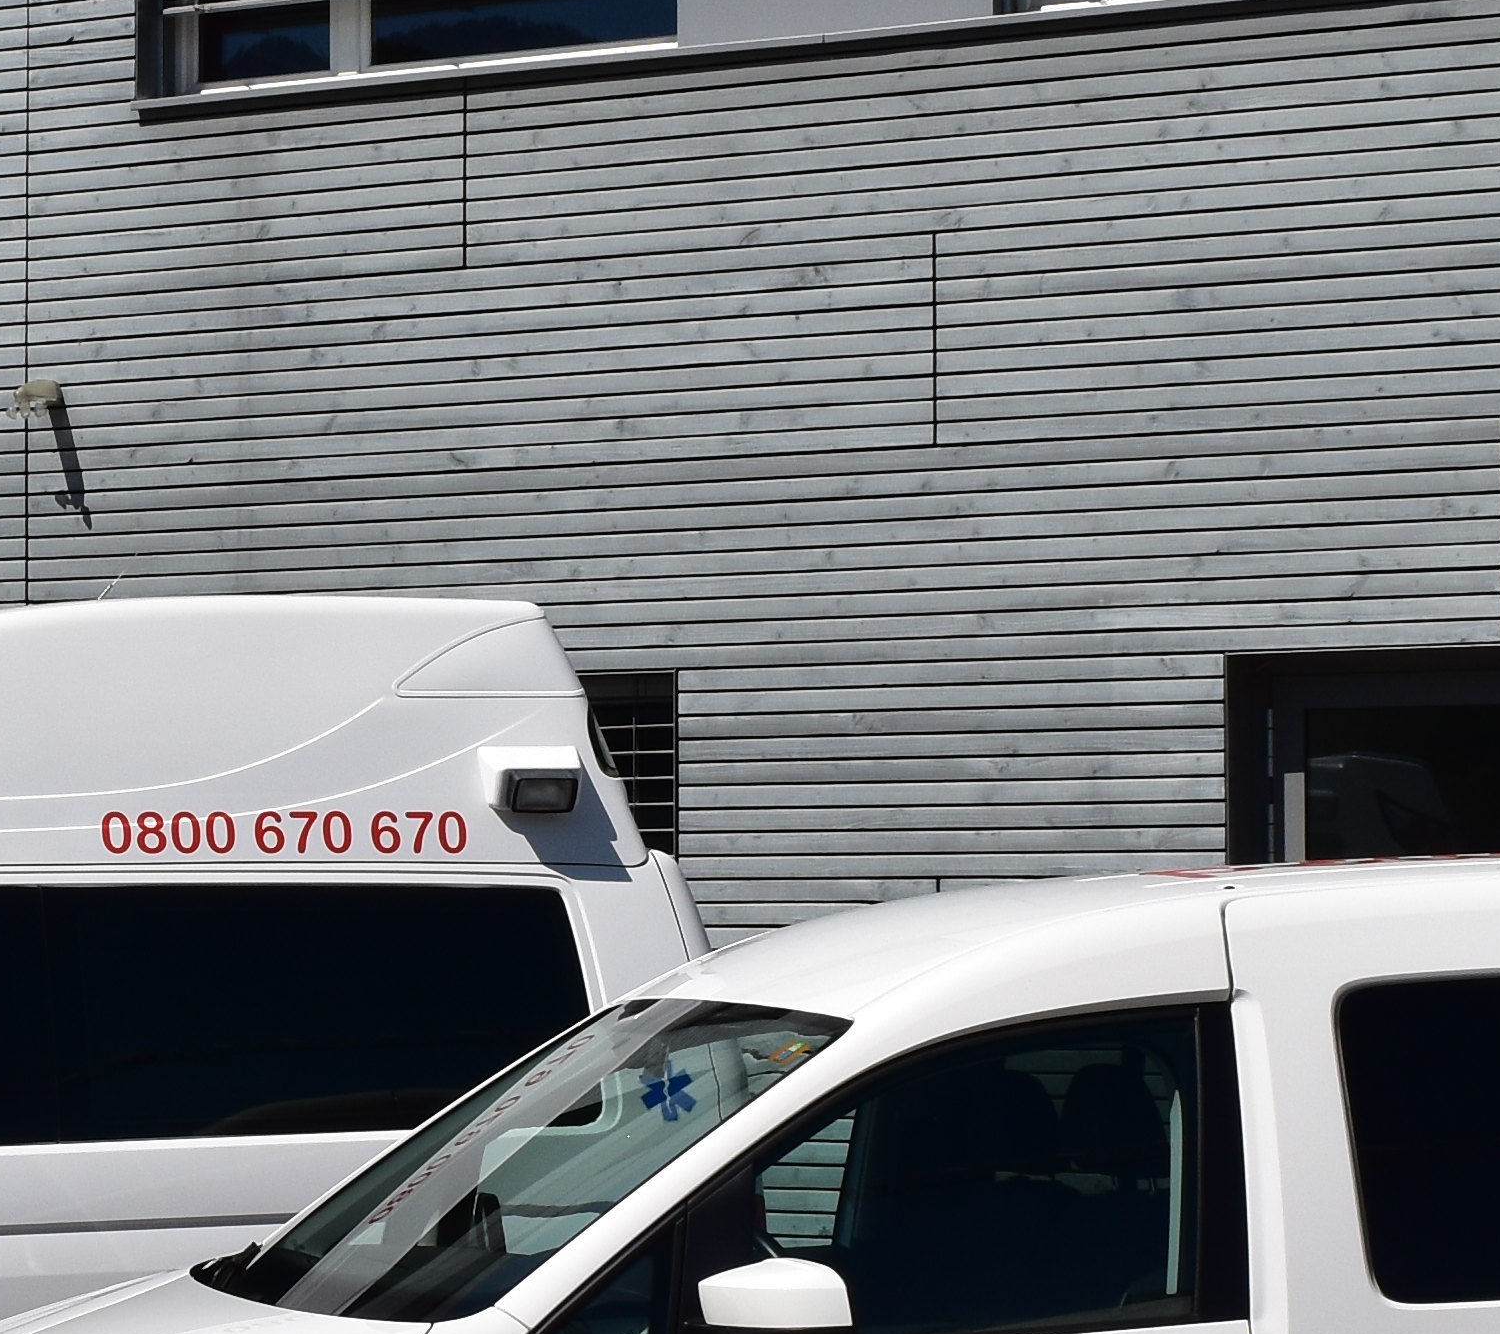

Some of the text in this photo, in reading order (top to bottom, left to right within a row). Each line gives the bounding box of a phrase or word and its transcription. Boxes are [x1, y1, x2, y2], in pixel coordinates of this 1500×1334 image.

[101, 810, 468, 854] 0800 670 670
